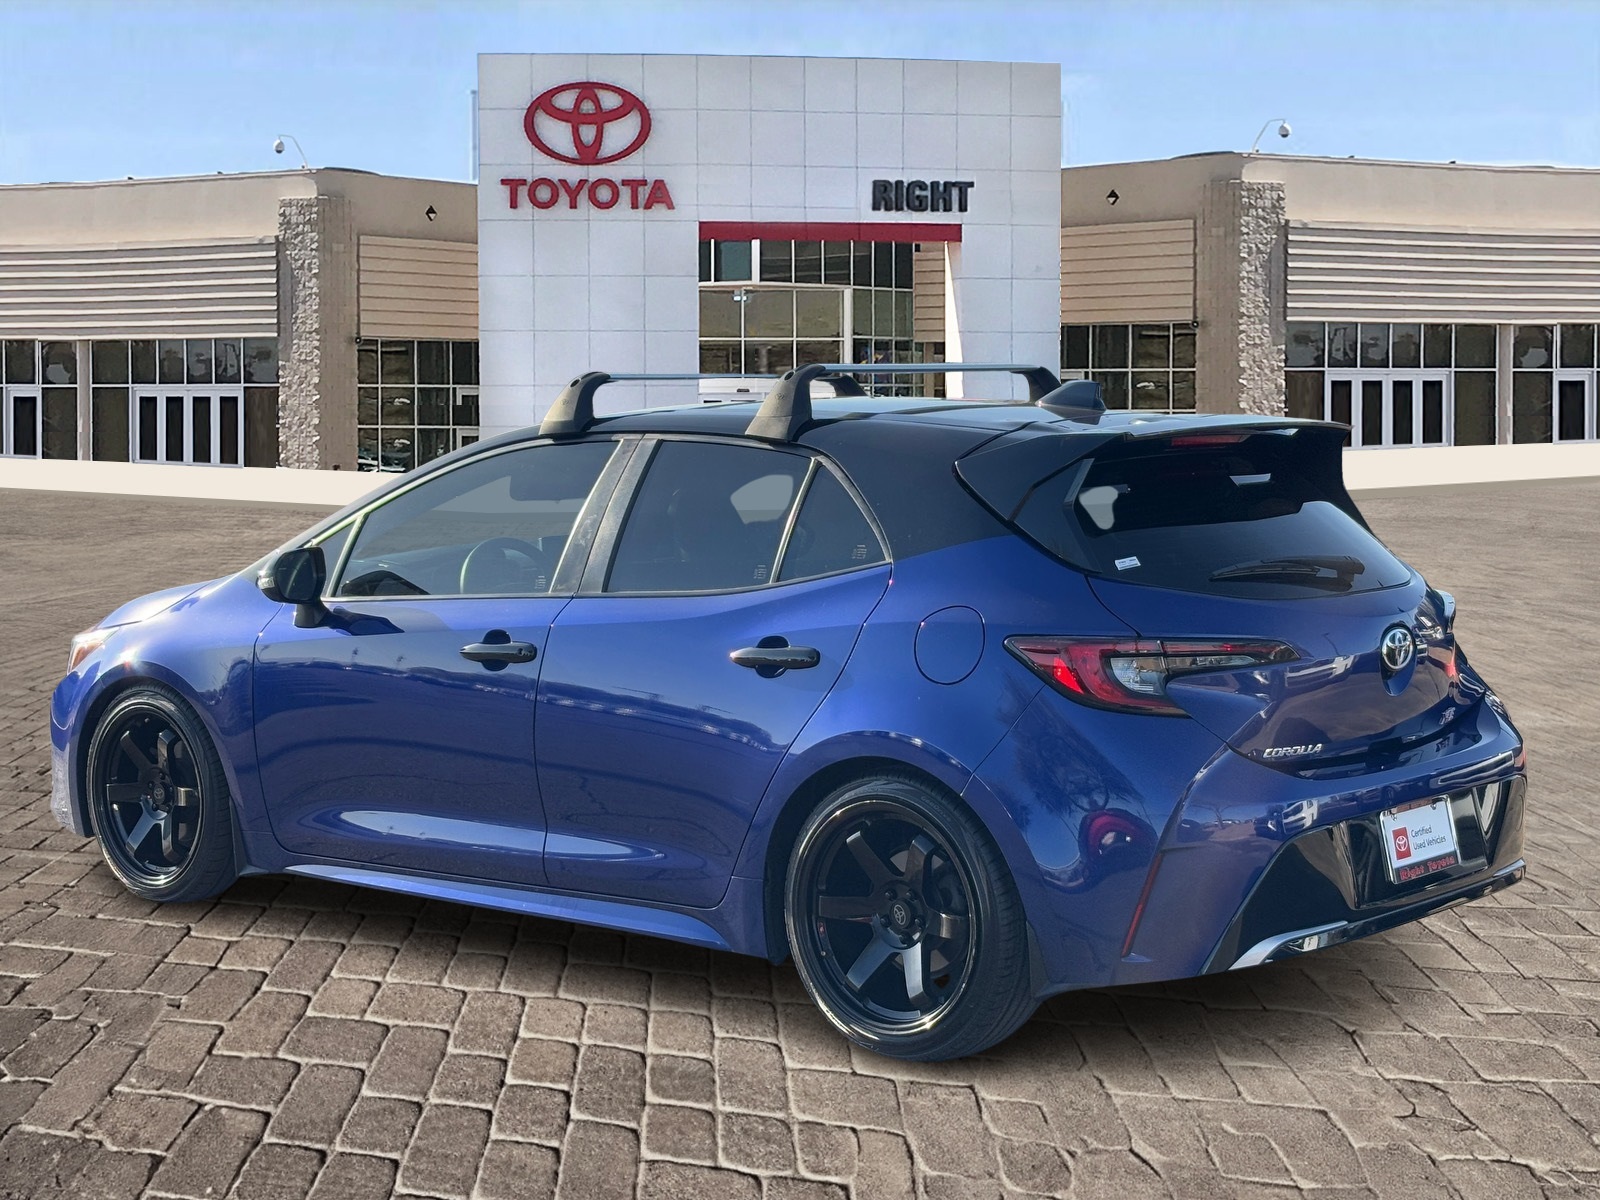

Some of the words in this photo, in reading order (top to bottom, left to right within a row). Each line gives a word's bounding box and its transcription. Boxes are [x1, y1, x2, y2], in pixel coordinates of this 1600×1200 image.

[500, 177, 675, 210] TOYOTA
[872, 179, 975, 212] RIGHT
[1263, 743, 1323, 758] COROLLA
[1410, 825, 1433, 838] Certified
[1412, 840, 1427, 850] Used
[1425, 835, 1447, 847] Vehicles
[1400, 864, 1425, 880] Right
[1427, 855, 1455, 872] Toyota
